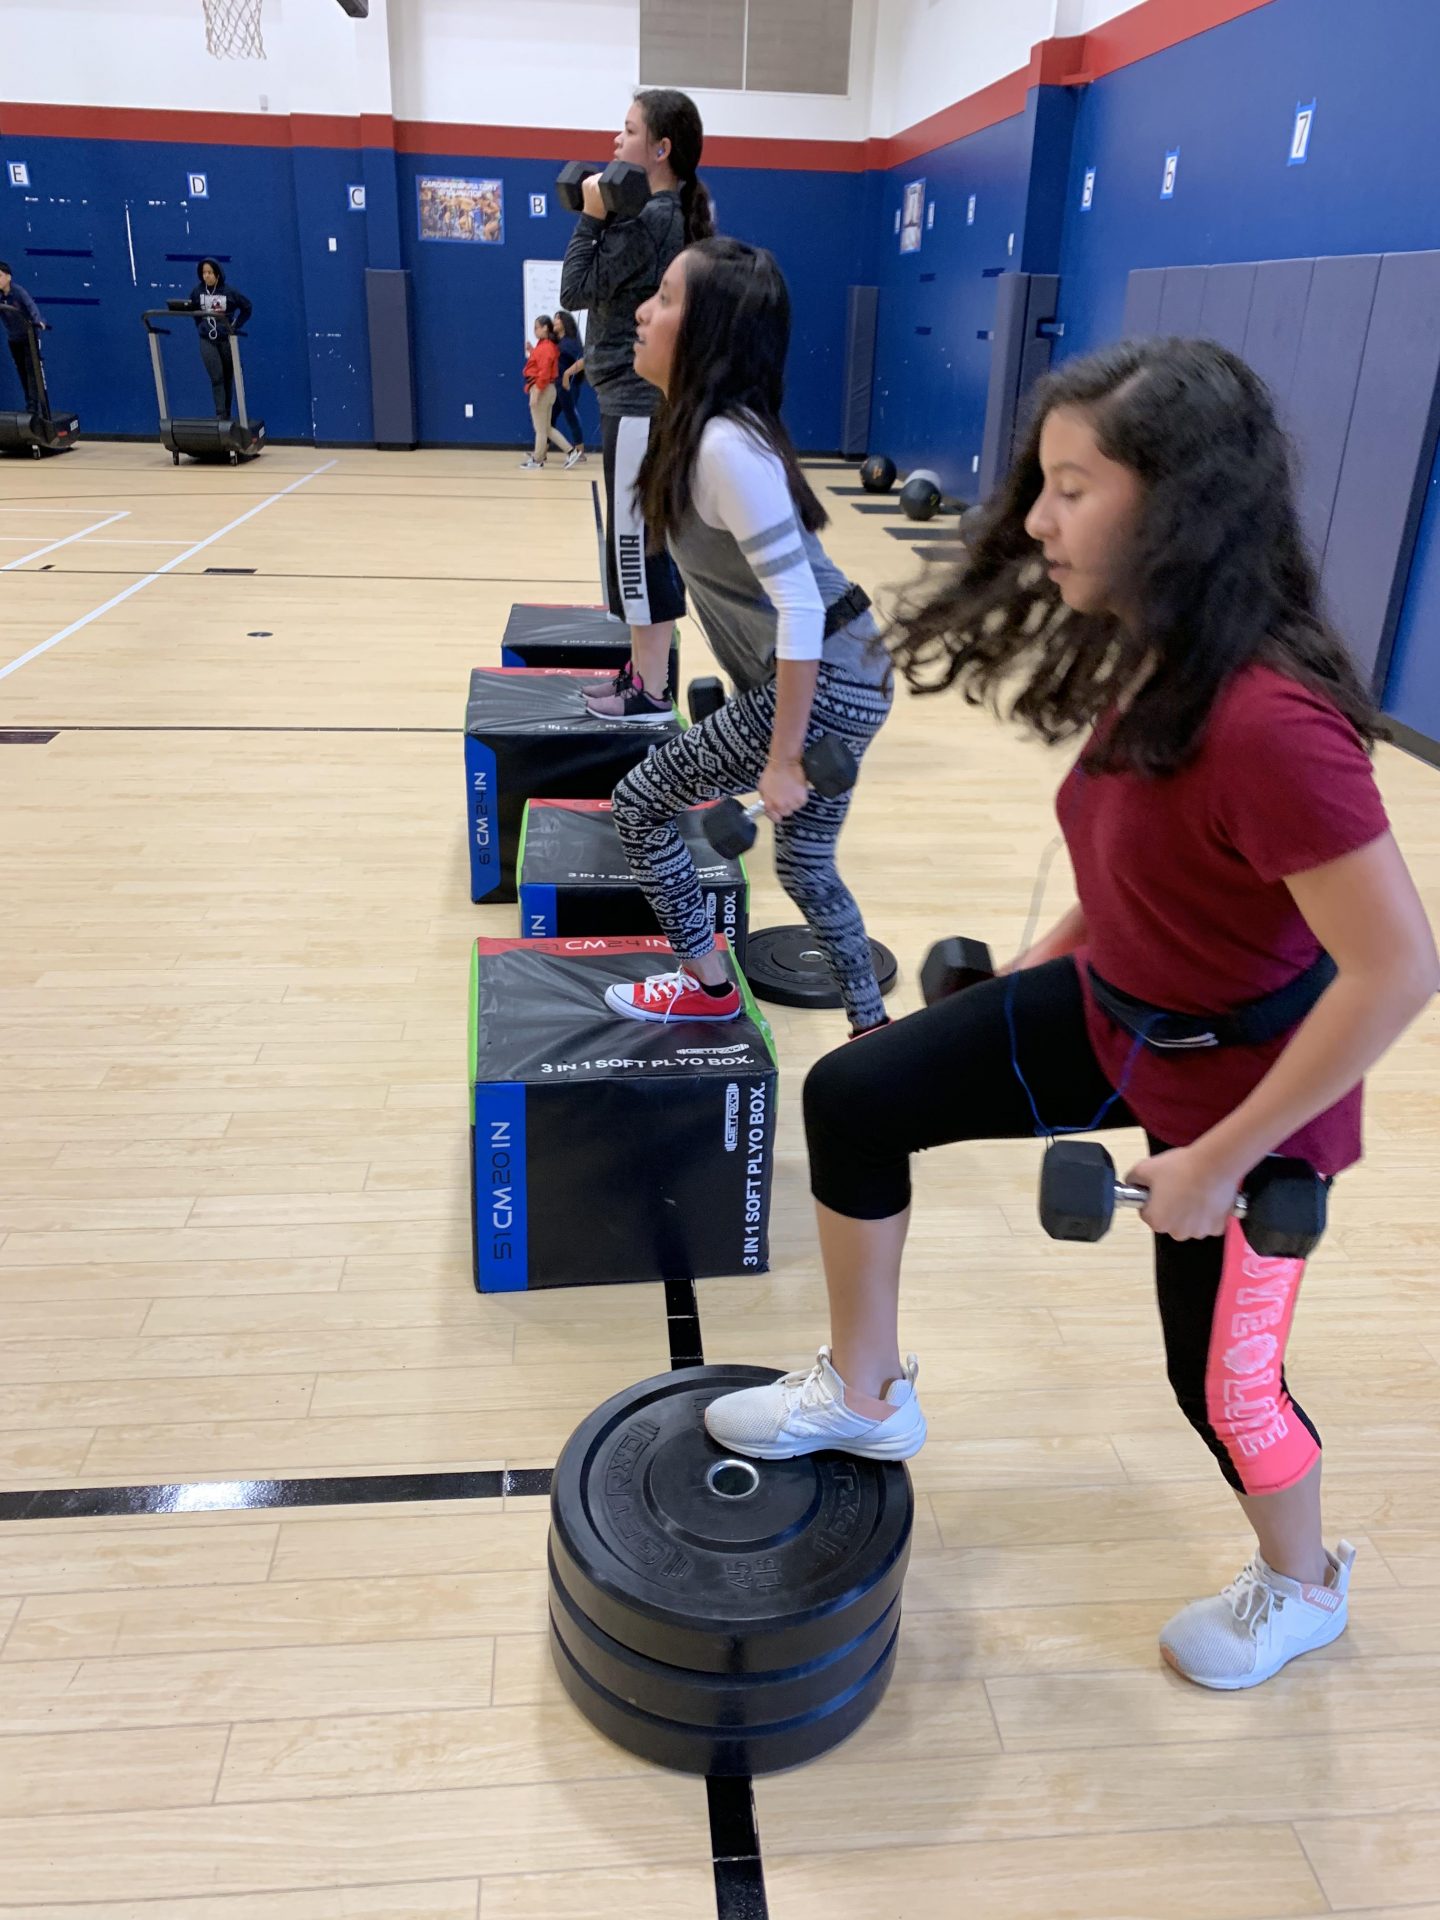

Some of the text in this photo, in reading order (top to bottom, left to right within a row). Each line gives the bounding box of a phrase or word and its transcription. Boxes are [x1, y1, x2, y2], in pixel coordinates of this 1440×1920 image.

[1296, 113, 1309, 154] 7
[12, 165, 24, 183] E
[192, 176, 205, 194] D
[1165, 158, 1176, 191] 6
[352, 188, 364, 206] C
[1083, 176, 1093, 204] 5
[533, 197, 544, 214] B
[619, 534, 644, 600] PUMA
[724, 891, 737, 924] BOX.
[540, 1054, 755, 1073] 3 IN 1 SOFT PLYO BOX.
[743, 1081, 766, 1266] 3 IN 1 SOFT PLYO BOX.
[1306, 1587, 1340, 1611] PUMA
